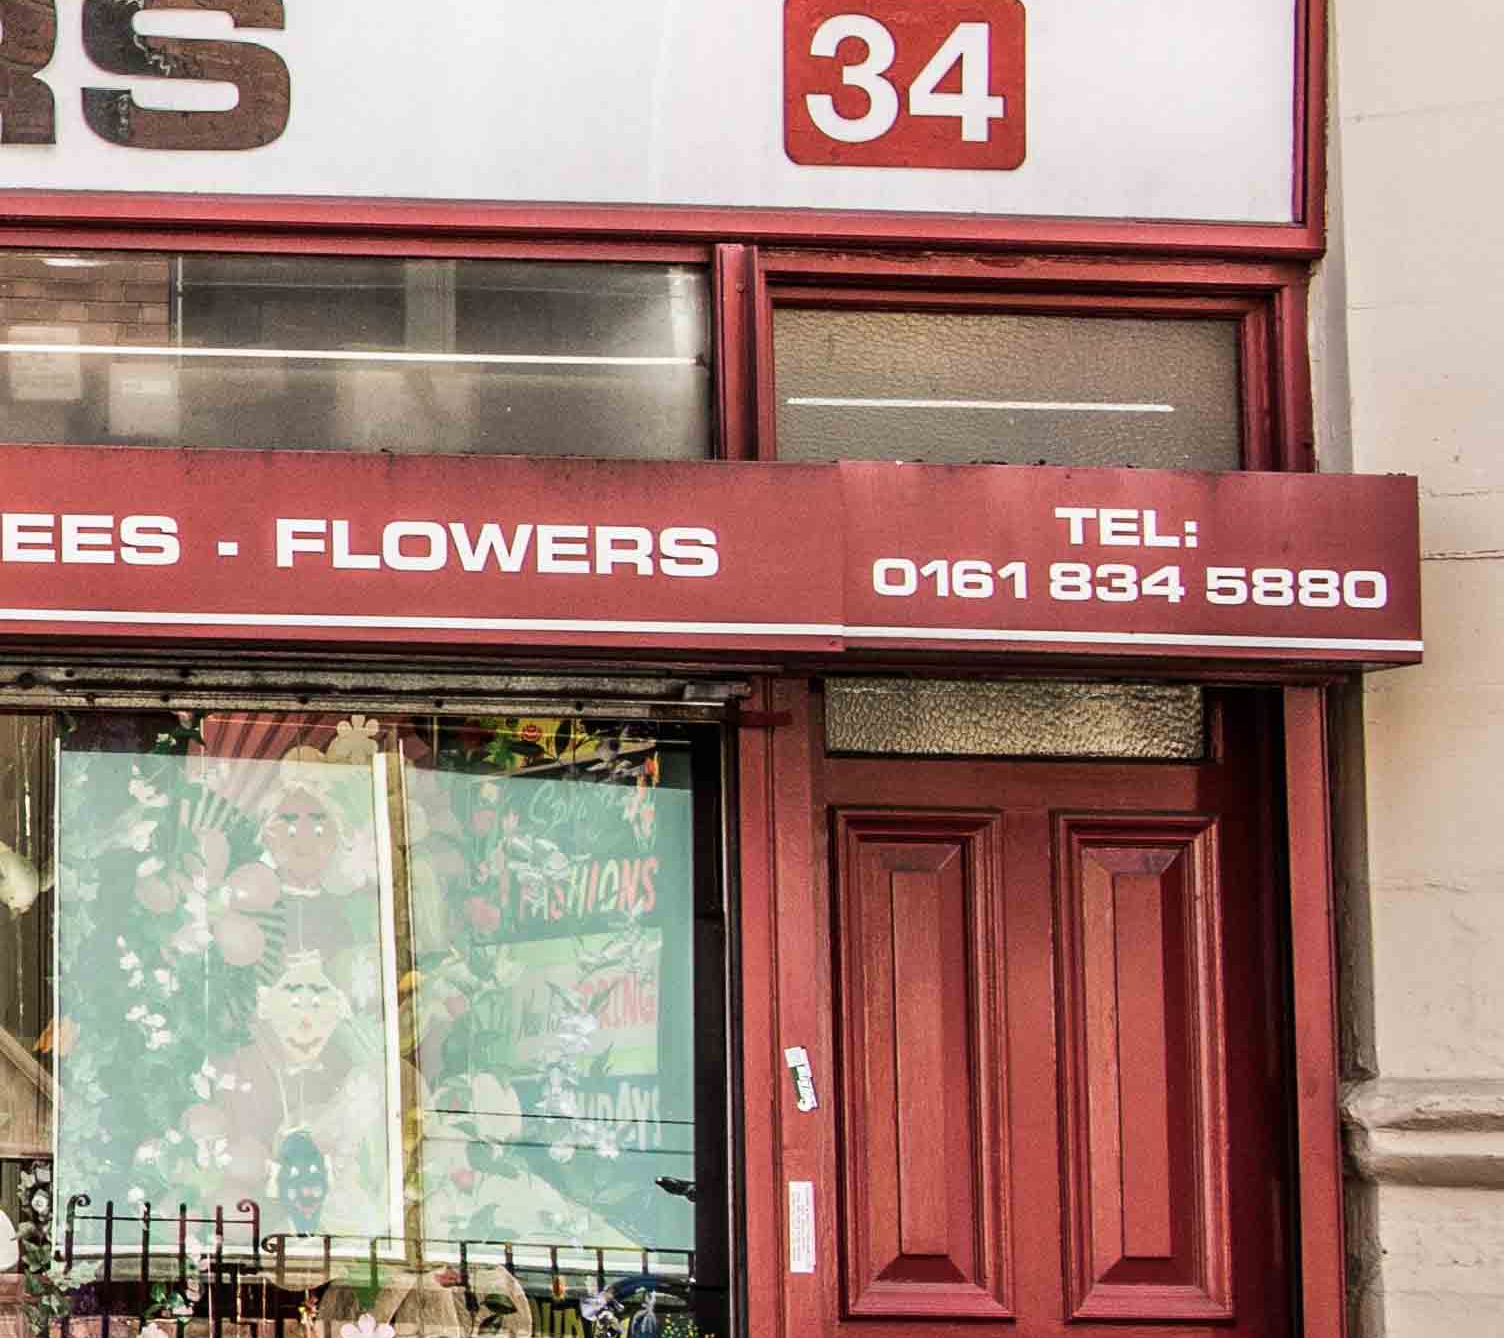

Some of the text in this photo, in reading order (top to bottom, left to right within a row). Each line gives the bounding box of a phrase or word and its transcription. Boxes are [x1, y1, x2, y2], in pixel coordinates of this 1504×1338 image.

[805, 13, 1004, 144] 34
[275, 517, 720, 578] FLOWERS
[1053, 506, 1199, 549] TEL:
[871, 557, 1389, 609] 0161 834 5880
